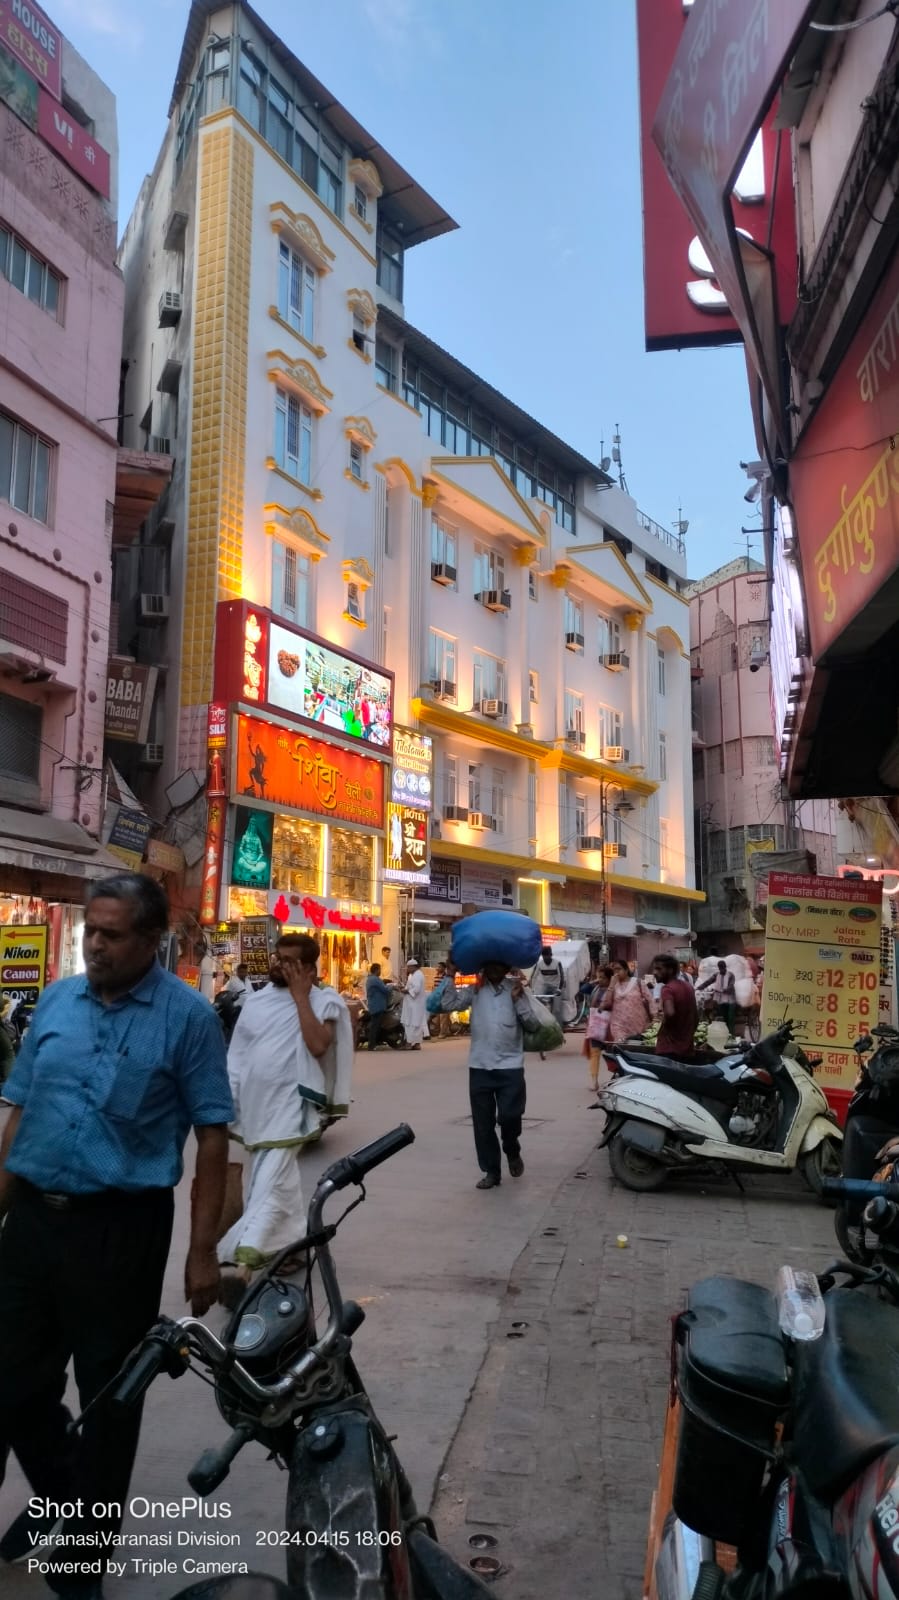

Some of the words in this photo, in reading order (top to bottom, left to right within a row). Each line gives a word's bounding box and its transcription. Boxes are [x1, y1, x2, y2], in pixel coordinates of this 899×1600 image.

[12, 0, 56, 59] HOUSE
[106, 677, 142, 703] BABA
[209, 724, 226, 735] SILK
[796, 926, 820, 938] MRP
[833, 927, 866, 937] Jalans
[838, 936, 860, 945] Rate
[4, 946, 40, 960] Nikon
[3, 968, 39, 981] Canon
[828, 1052, 849, 1065] दाम
